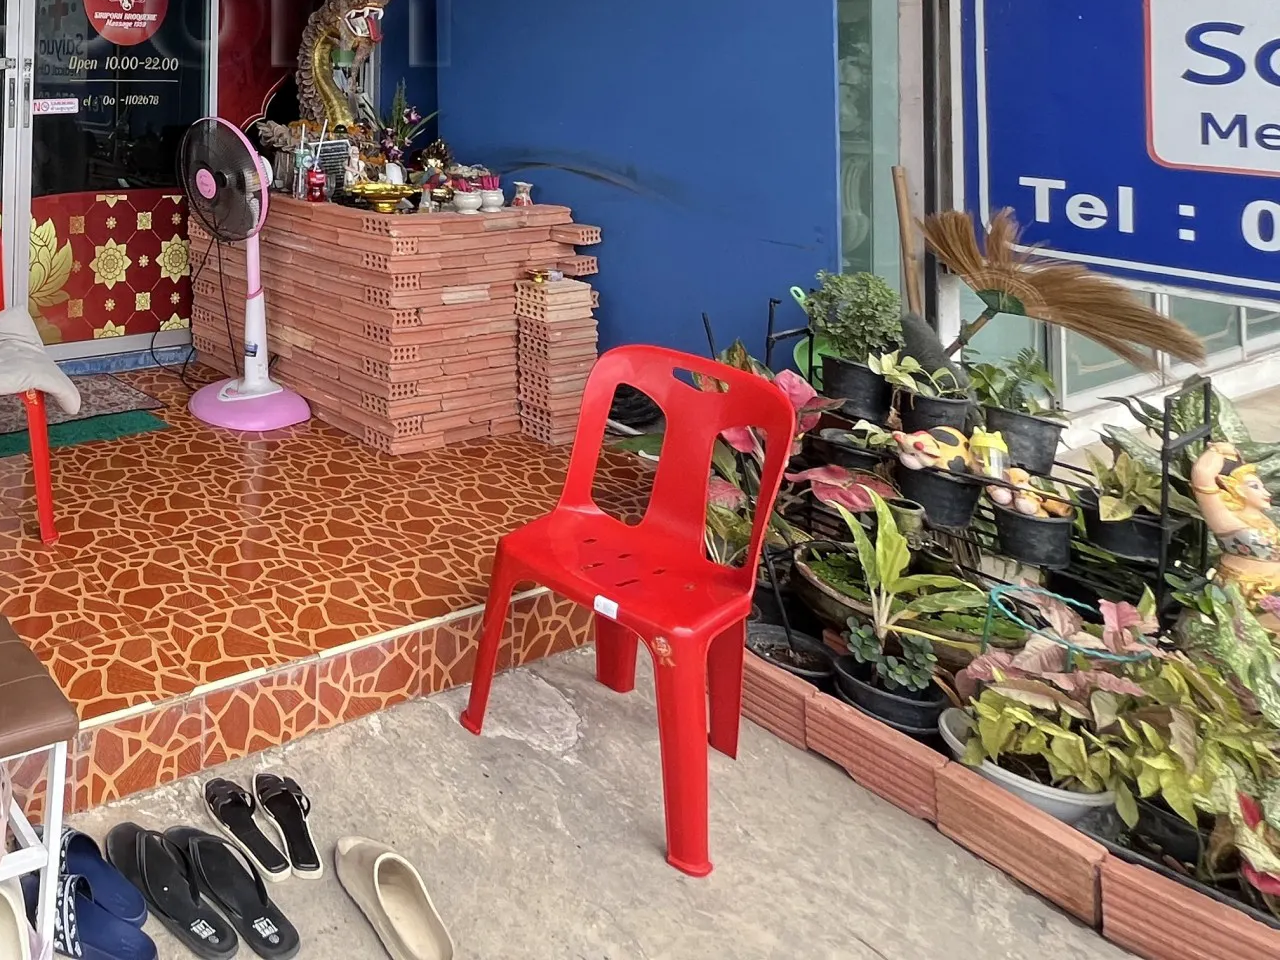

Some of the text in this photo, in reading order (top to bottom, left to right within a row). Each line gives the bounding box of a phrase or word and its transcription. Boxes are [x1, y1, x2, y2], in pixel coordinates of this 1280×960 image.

[69, 55, 97, 74] Open
[105, 56, 179, 71] 10.00-22.00
[1019, 175, 1134, 234] Tel
